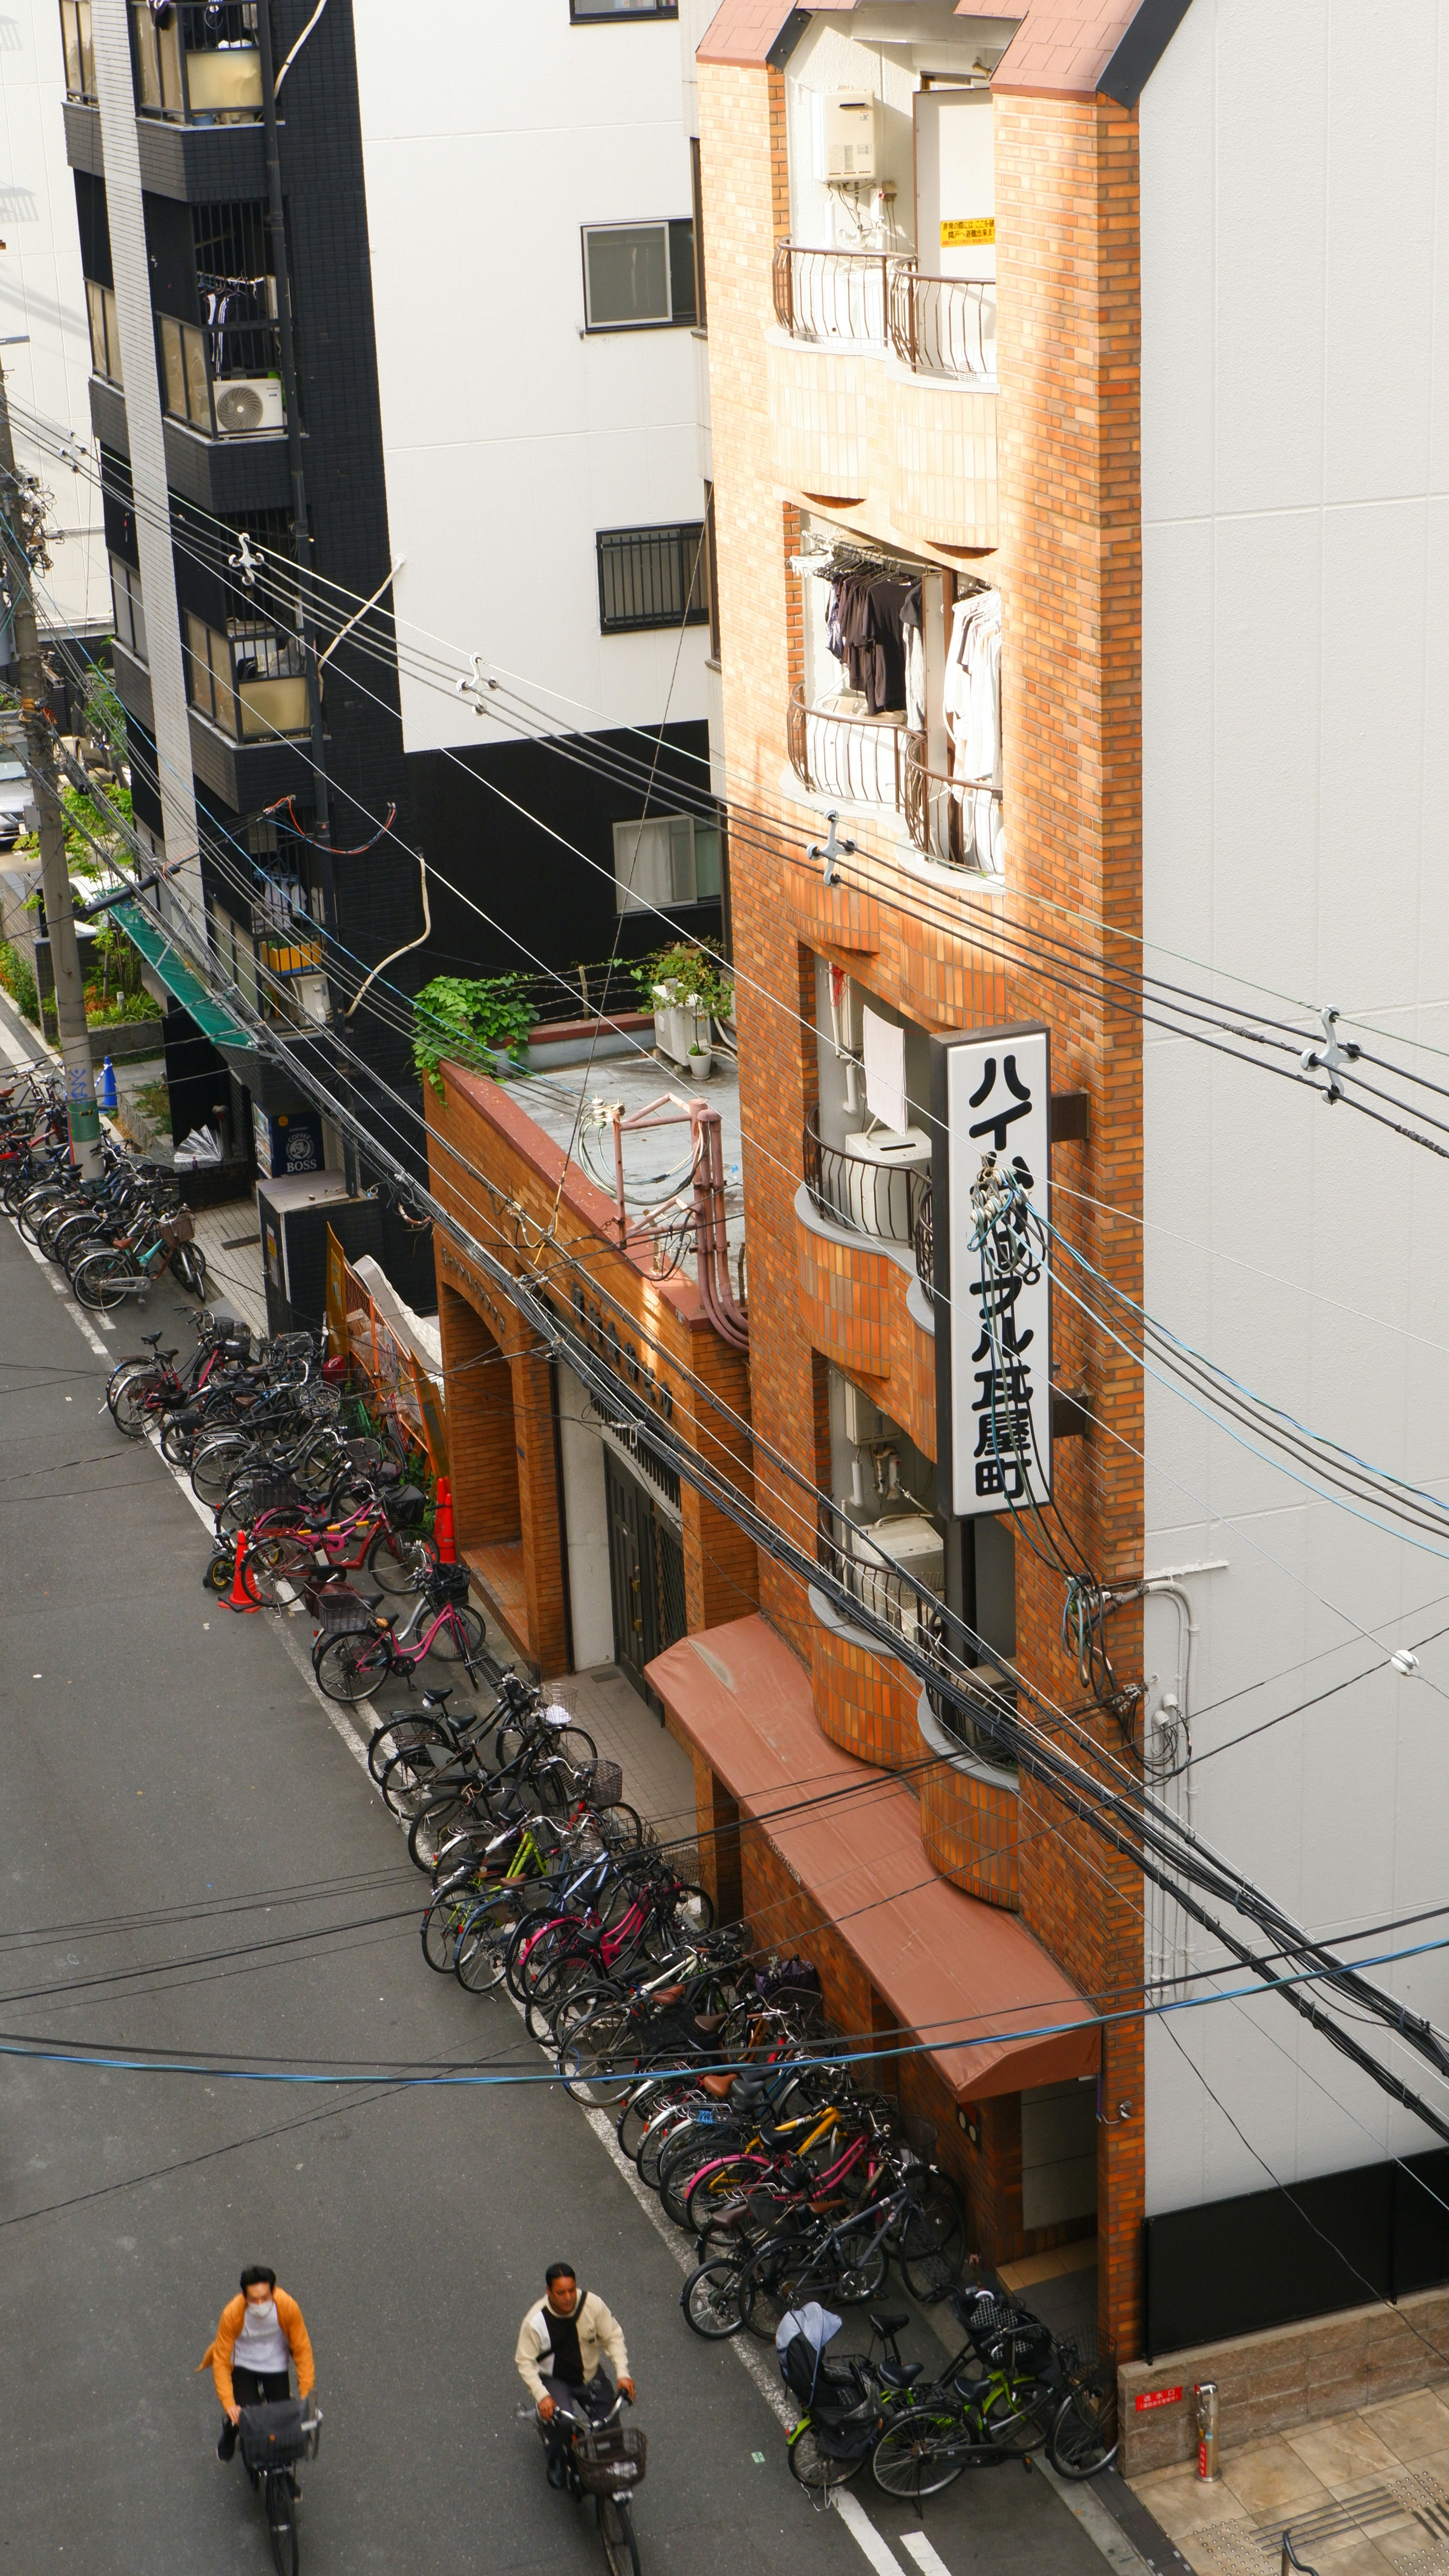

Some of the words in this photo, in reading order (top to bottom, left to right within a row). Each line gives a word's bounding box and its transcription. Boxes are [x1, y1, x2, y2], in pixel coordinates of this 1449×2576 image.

[288, 1133, 311, 1142] COFFEE
[286, 1159, 317, 1173] BOSS
[1143, 2389, 1175, 2402] 送水口
